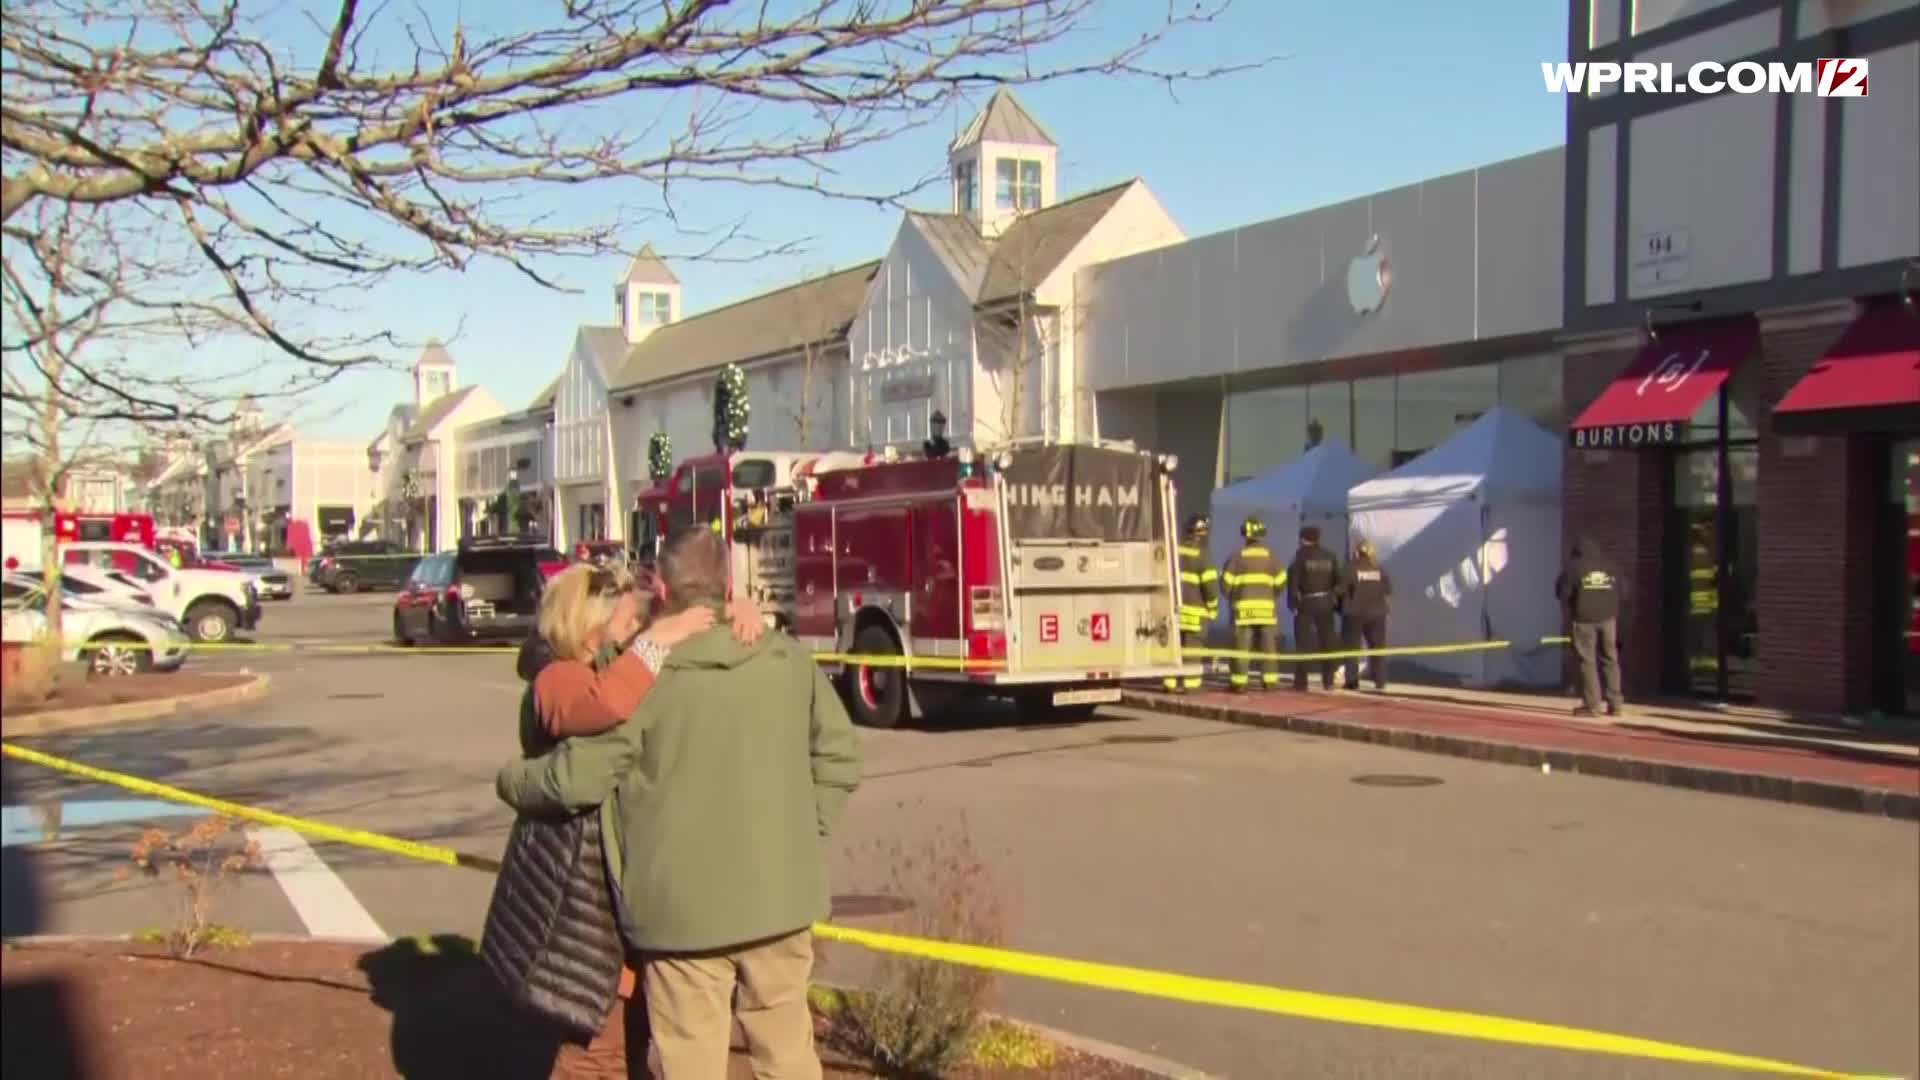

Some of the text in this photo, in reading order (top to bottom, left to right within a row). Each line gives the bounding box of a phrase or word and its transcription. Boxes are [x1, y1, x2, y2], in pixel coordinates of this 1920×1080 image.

[1575, 423, 1674, 447] BURTONS
[1041, 617, 1108, 640] E 4
